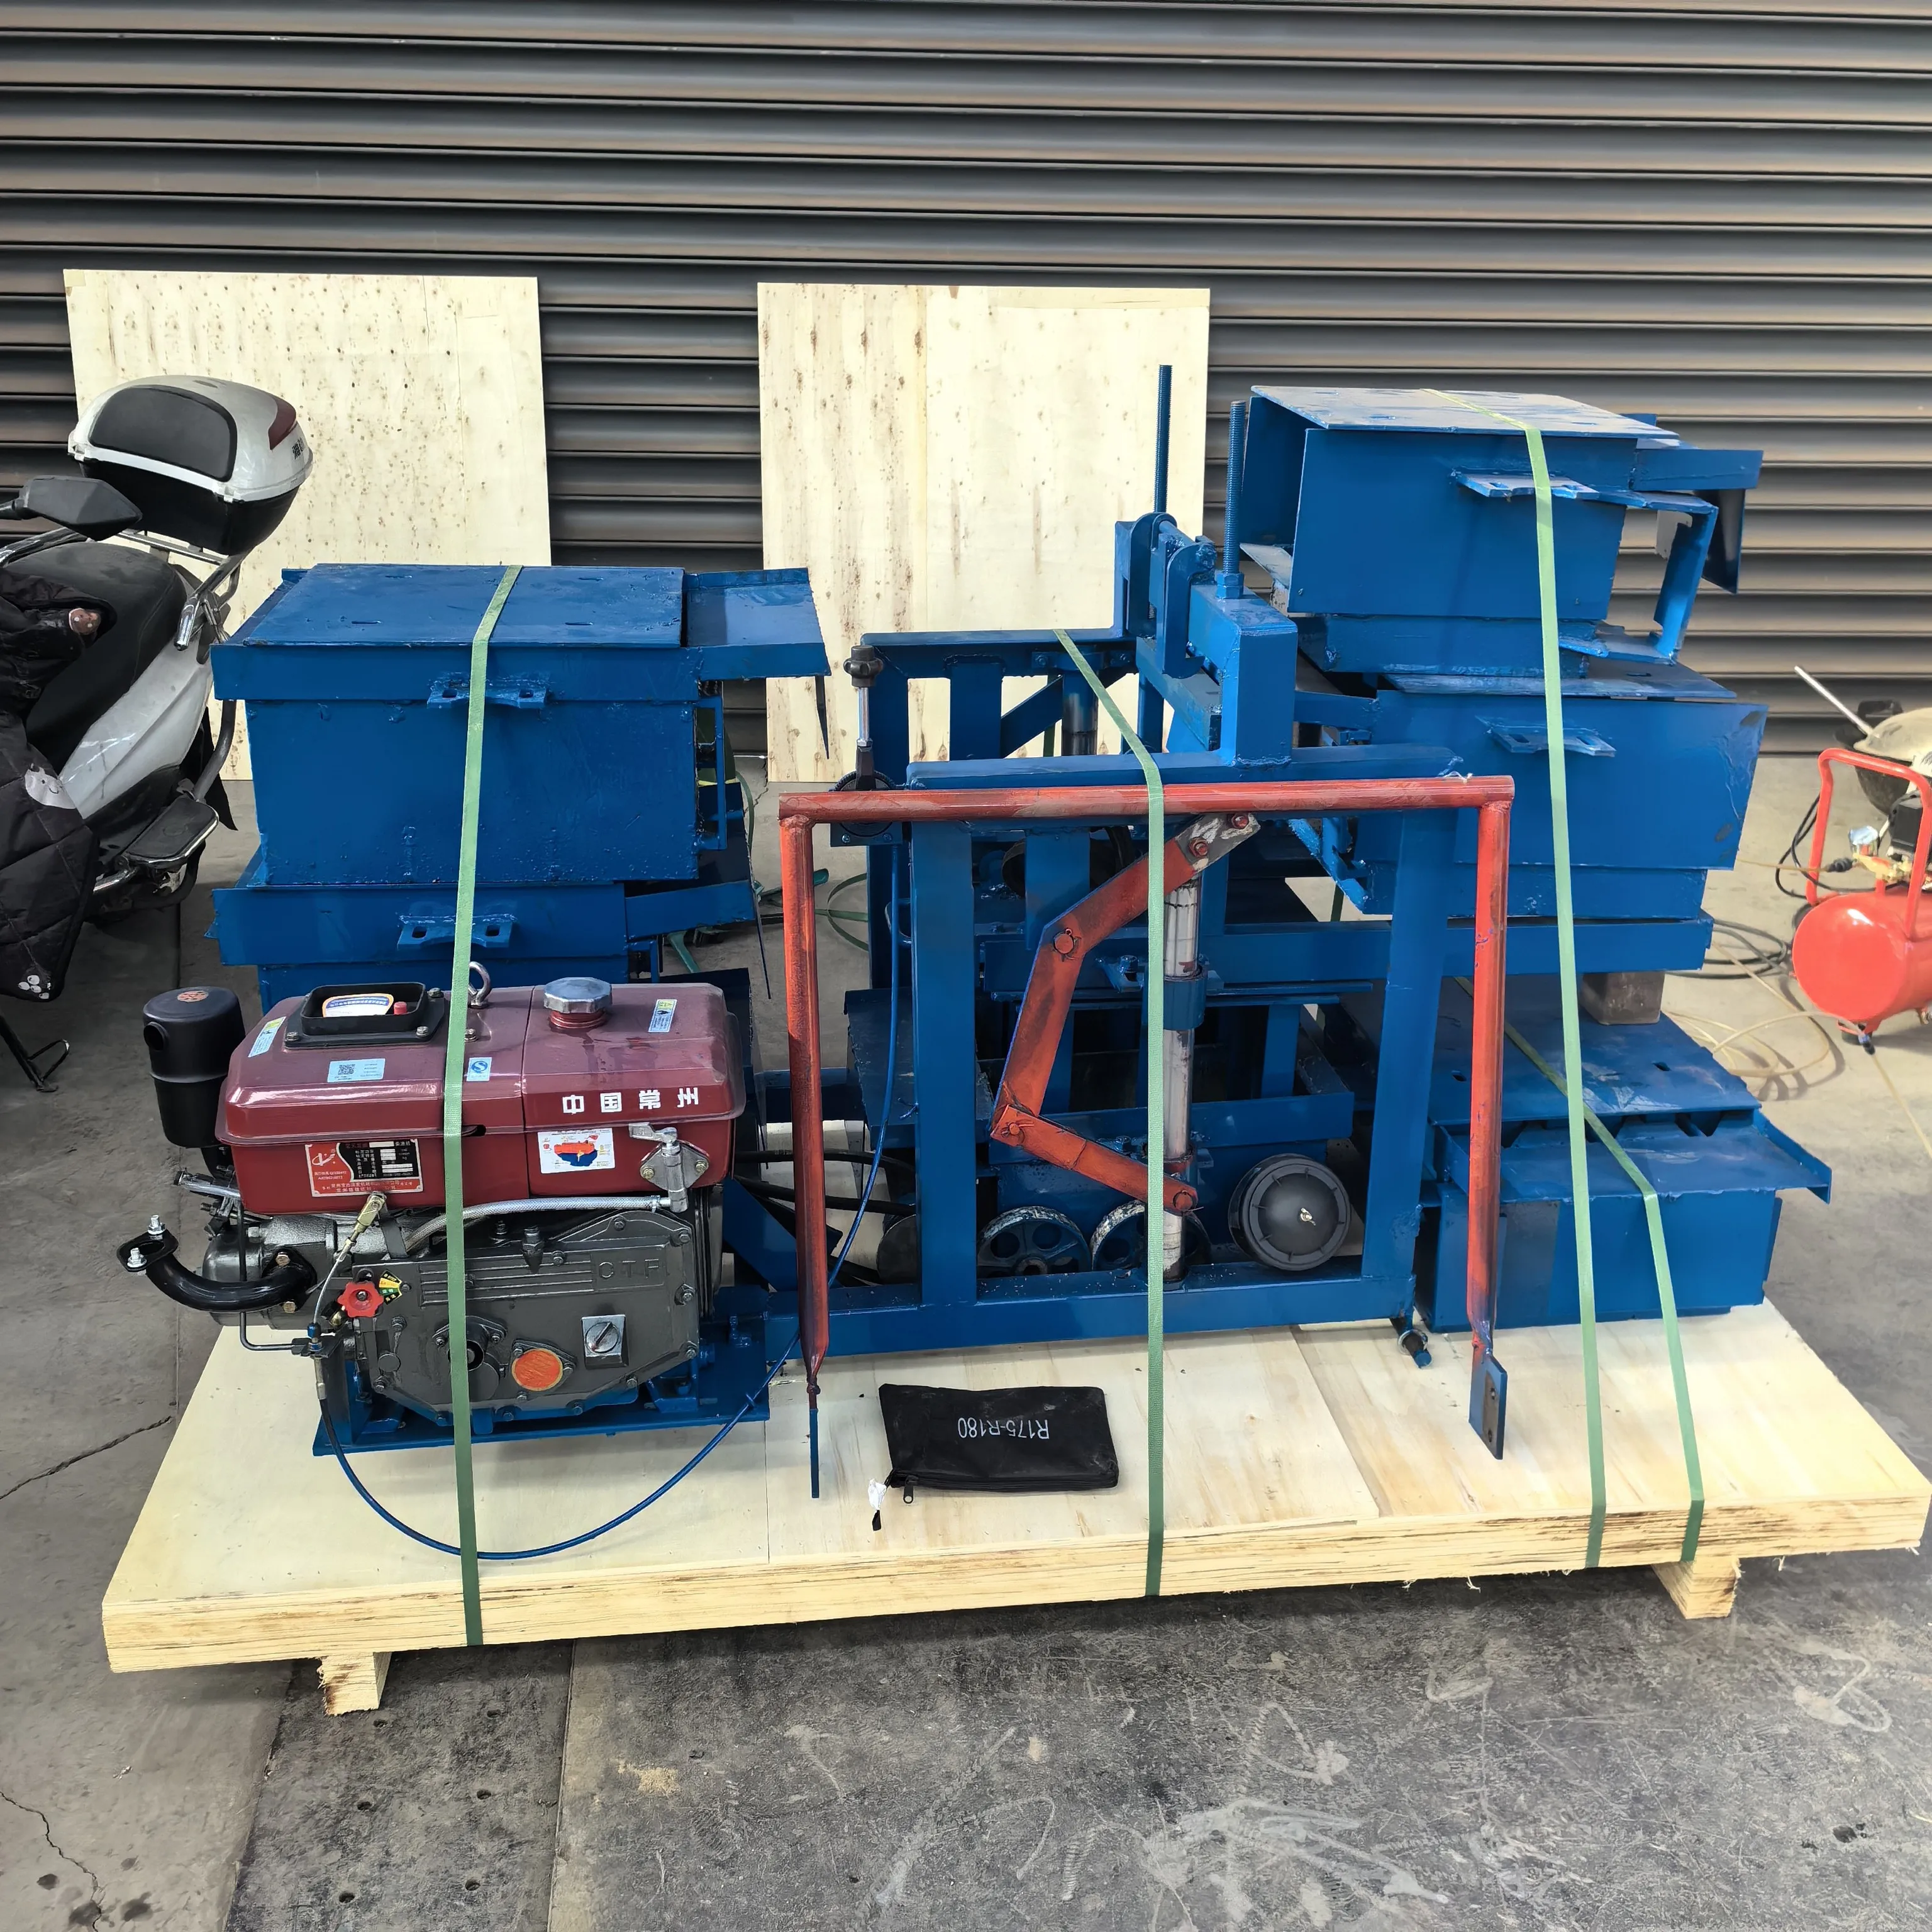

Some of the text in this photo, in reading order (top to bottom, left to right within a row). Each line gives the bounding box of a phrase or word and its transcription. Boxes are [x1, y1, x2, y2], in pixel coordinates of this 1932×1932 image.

[562, 1087, 699, 1114] 中国常州
[958, 1417, 1050, 1440] R175-R180
